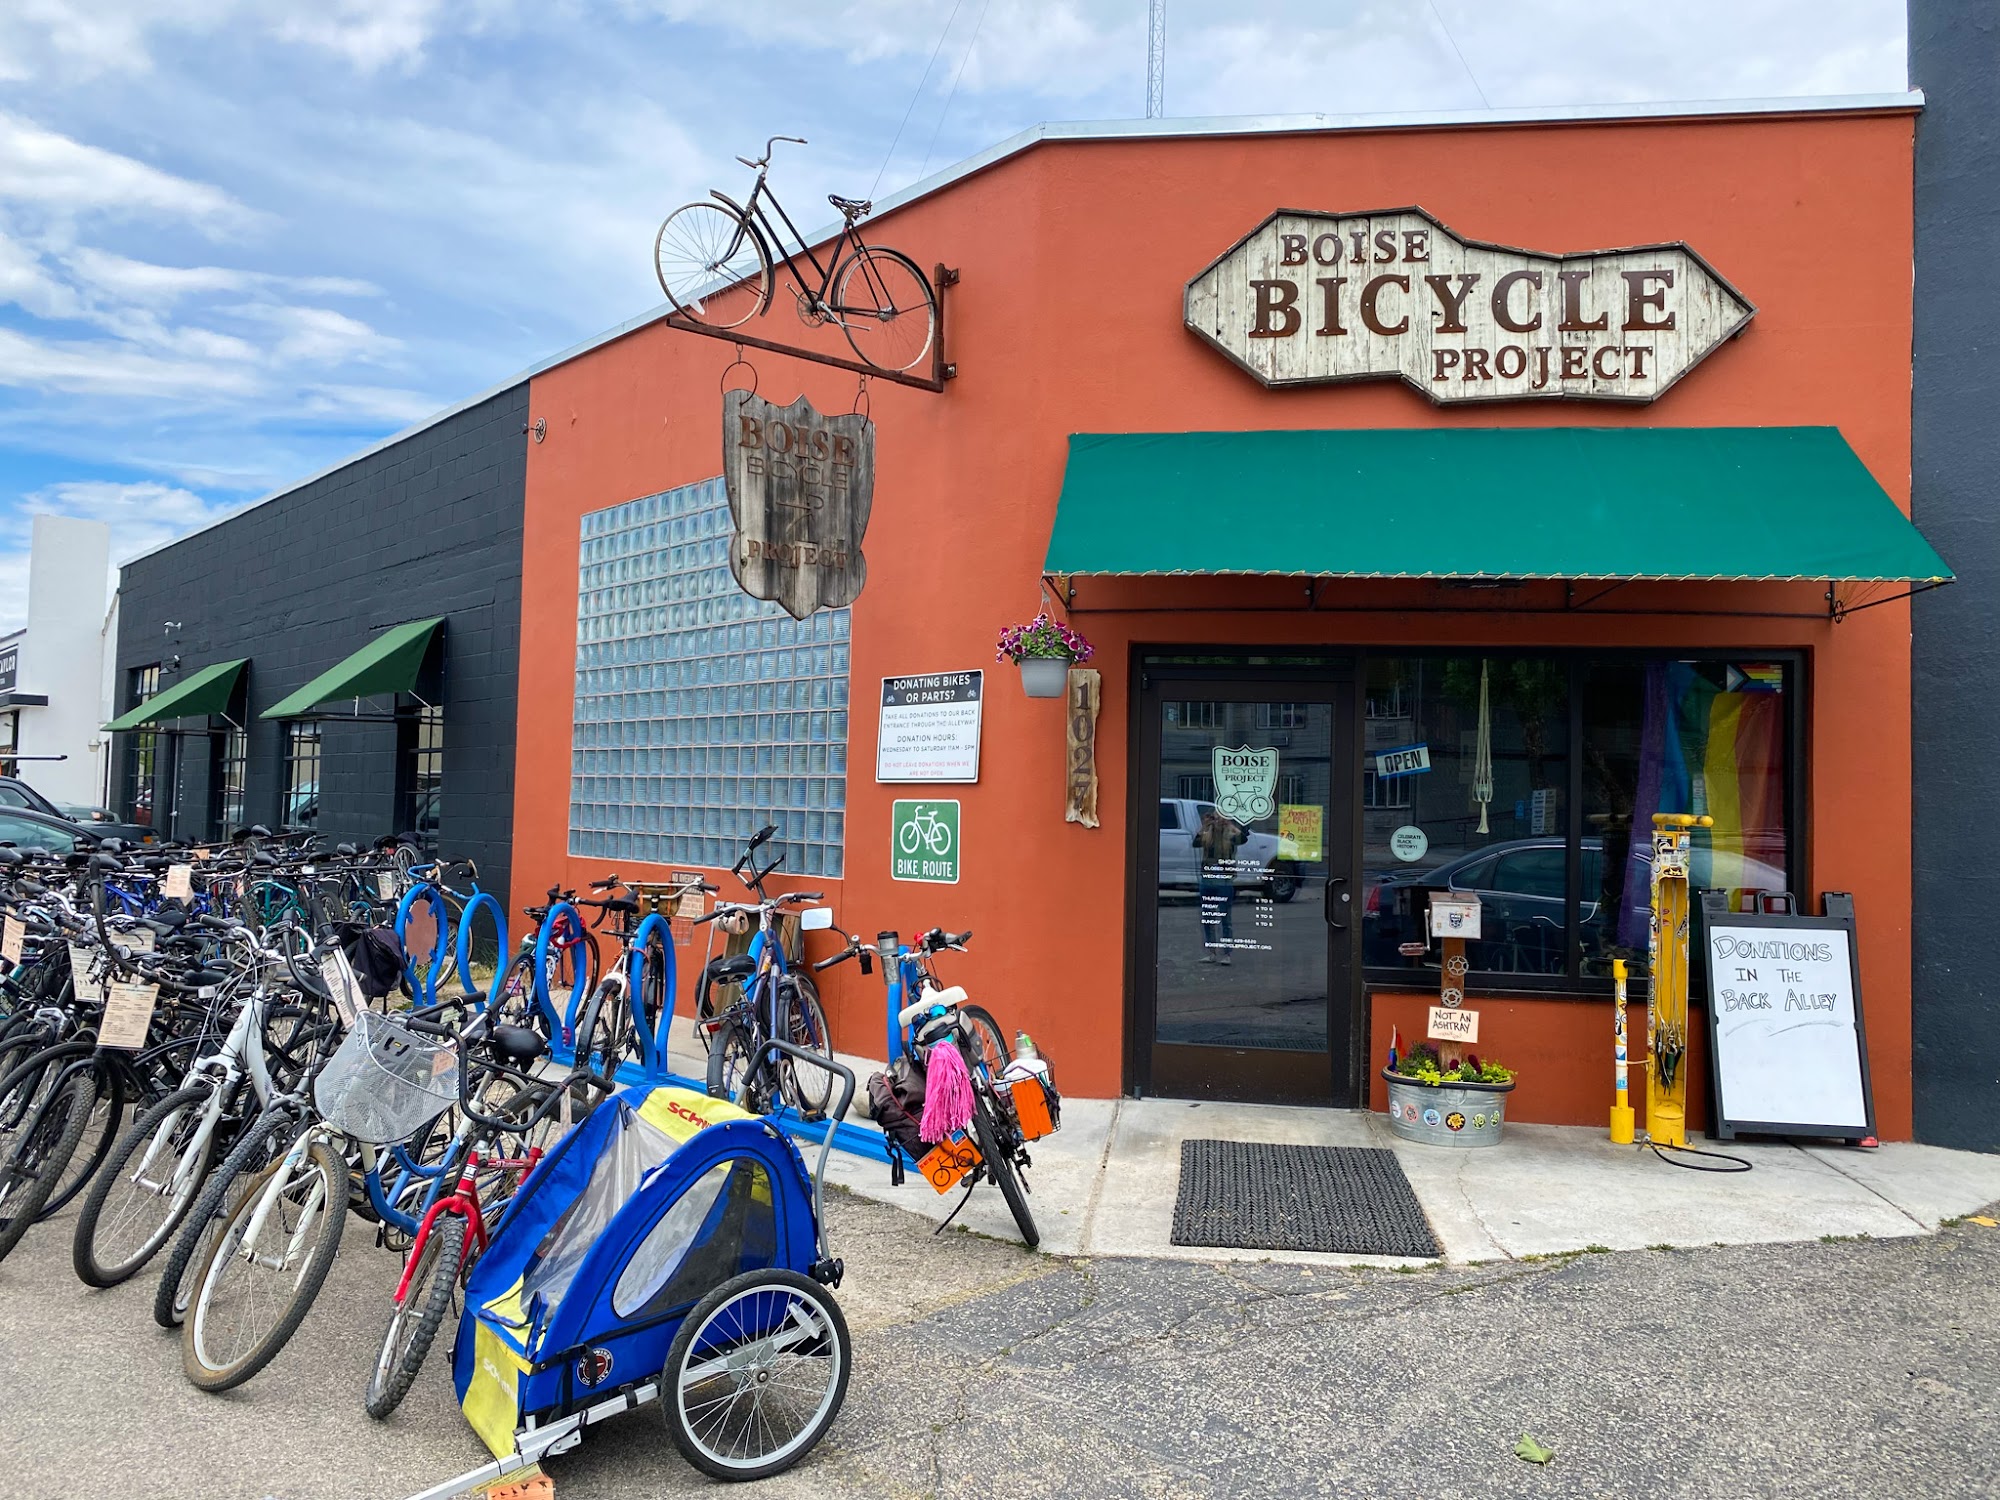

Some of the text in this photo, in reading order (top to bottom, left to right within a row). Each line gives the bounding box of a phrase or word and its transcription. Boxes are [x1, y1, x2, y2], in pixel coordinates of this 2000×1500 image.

[1280, 229, 1430, 266] BOISE
[1248, 269, 1676, 338] BICYCLE
[1432, 345, 1653, 389] PROJECT
[738, 414, 856, 467] BOISE
[893, 674, 971, 690] DONATING BIKES
[906, 690, 956, 703] OR PARTS?
[909, 711, 939, 719] DONATIONS
[897, 733, 958, 742] DONATION HOURS:
[1072, 682, 1094, 810] 1027
[1221, 755, 1270, 767] BOISE
[1384, 750, 1422, 774] OPEN
[1221, 767, 1269, 775] BICYCLE
[1225, 774, 1266, 783] PROJECT
[897, 858, 953, 877] BIKE ROUTE
[1204, 942, 1272, 950] BOISEBICYCLEPROJECT.ORG
[1713, 935, 1832, 962] DONATIONS
[1735, 967, 1803, 983] IN THE
[1721, 988, 1837, 1012] BACK ALLEY
[1435, 1009, 1471, 1023] NOT AN
[1432, 1020, 1471, 1034] ASHTRAY
